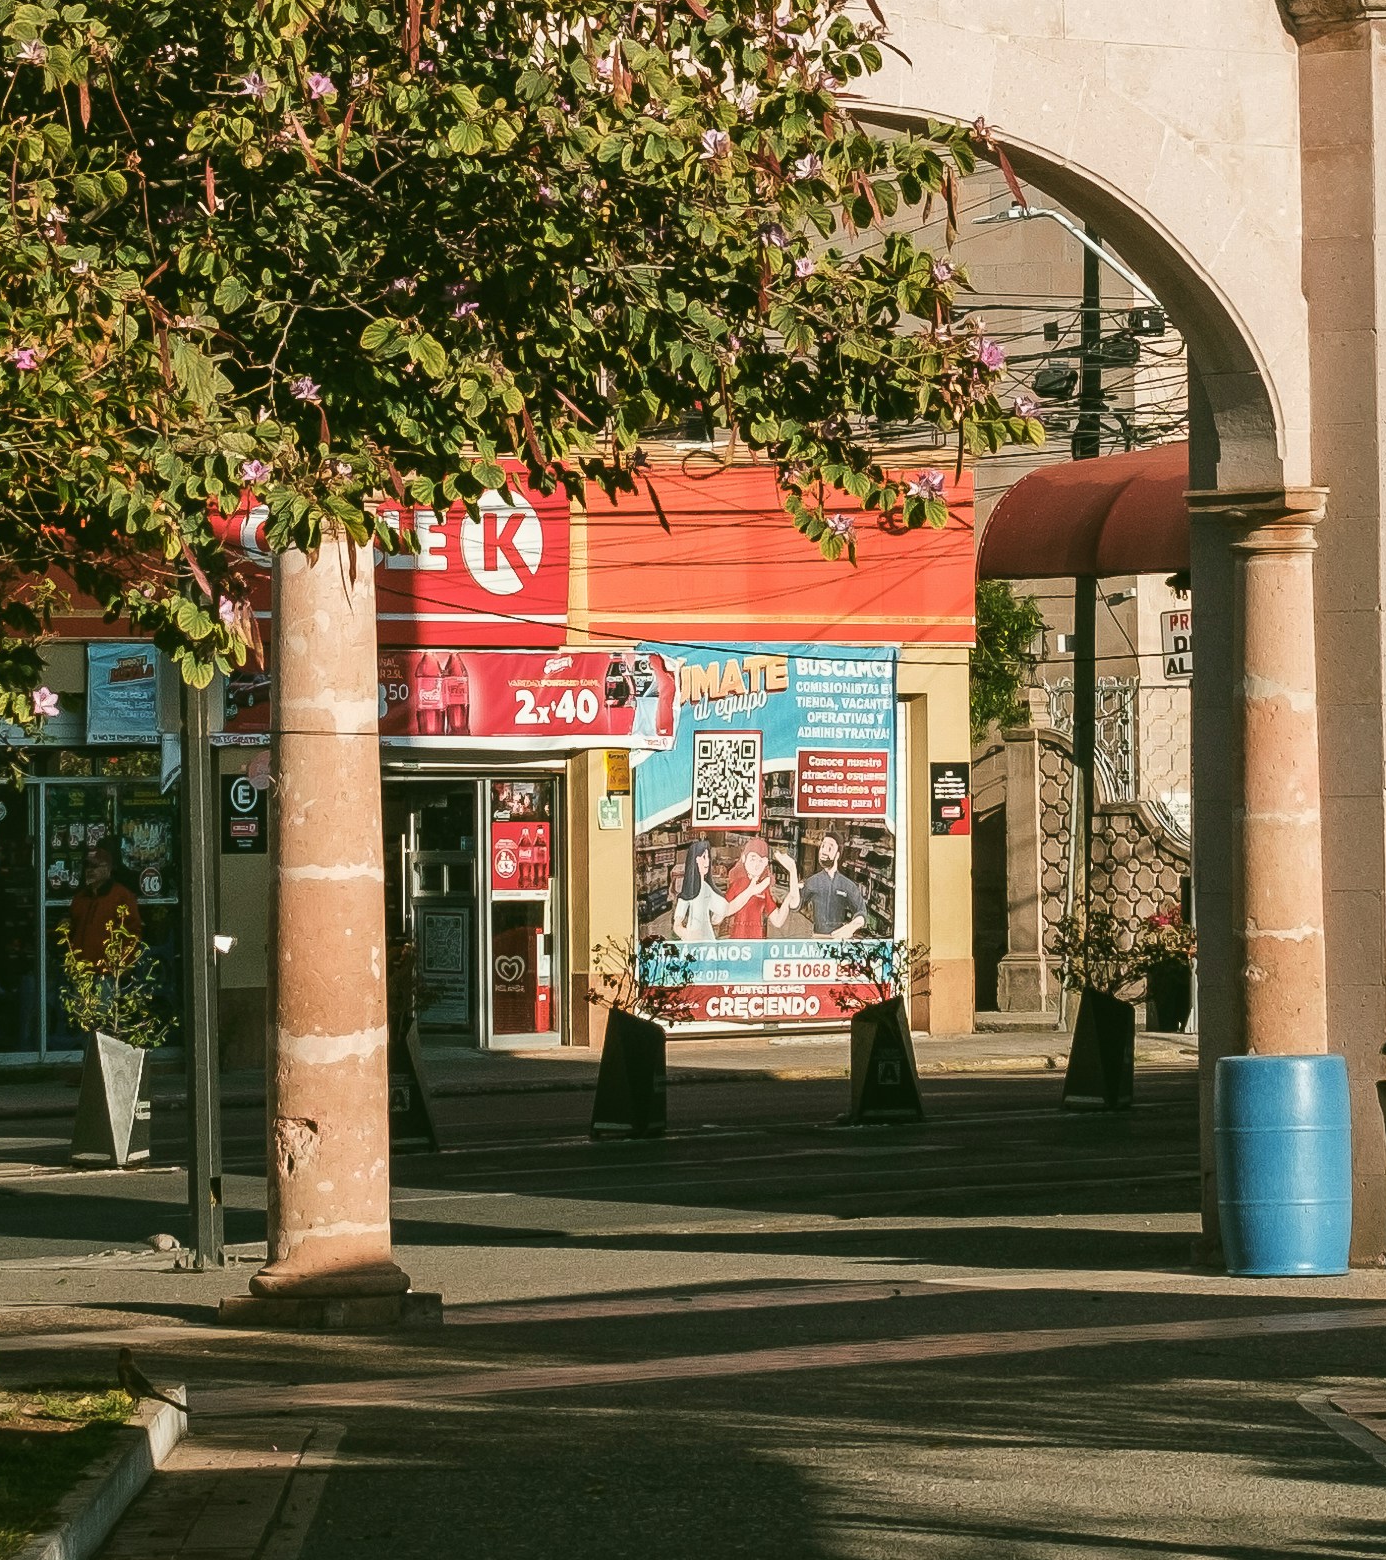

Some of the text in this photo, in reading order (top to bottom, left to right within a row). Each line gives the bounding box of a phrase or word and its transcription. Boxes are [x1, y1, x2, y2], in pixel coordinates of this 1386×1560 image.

[483, 513, 534, 572] K
[694, 690, 768, 724] al equipo
[876, 713, 885, 725] Y
[237, 784, 251, 805] E
[773, 963, 792, 978] 55
[795, 963, 831, 978] 1068
[705, 995, 822, 1018] CRECIENDO
